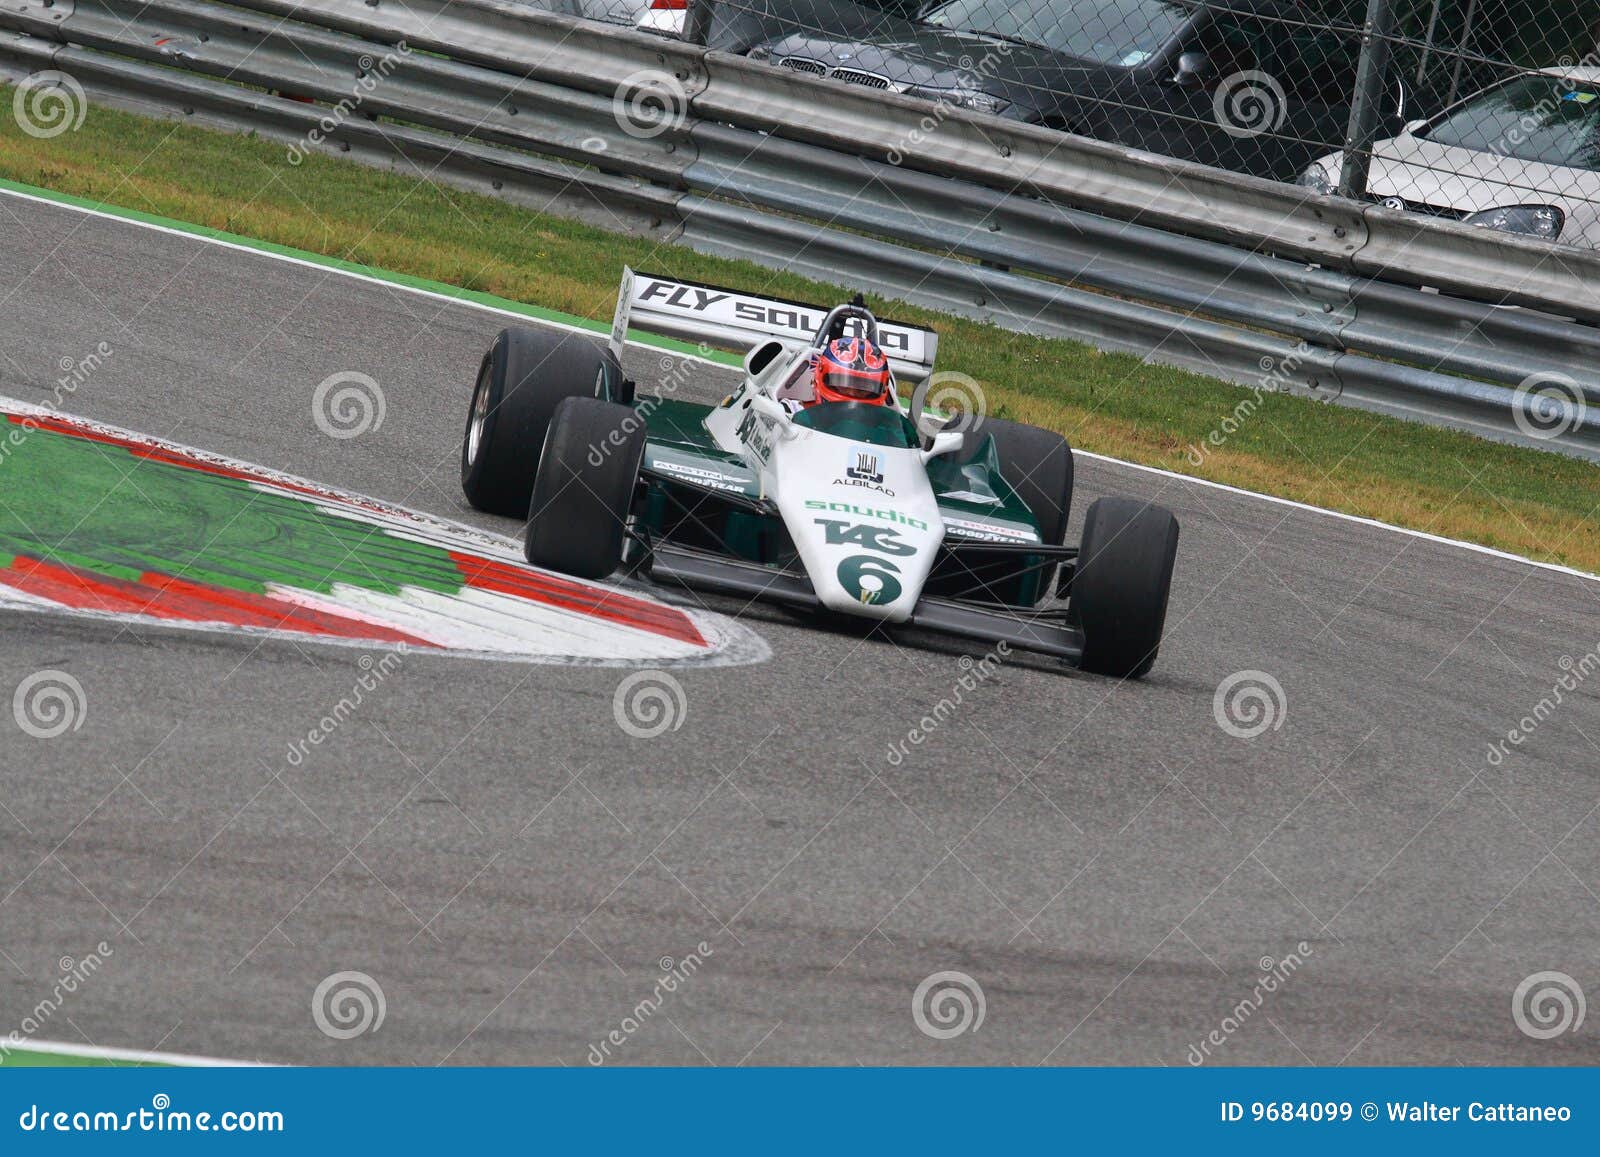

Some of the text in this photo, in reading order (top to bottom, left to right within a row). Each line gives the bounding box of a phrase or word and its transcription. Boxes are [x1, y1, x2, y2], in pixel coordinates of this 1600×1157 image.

[637, 281, 909, 350] FLY saua
[655, 461, 722, 479] AUSTIN
[832, 478, 896, 497] ALBILAD
[804, 500, 928, 531] saudia
[837, 555, 903, 606] 6
